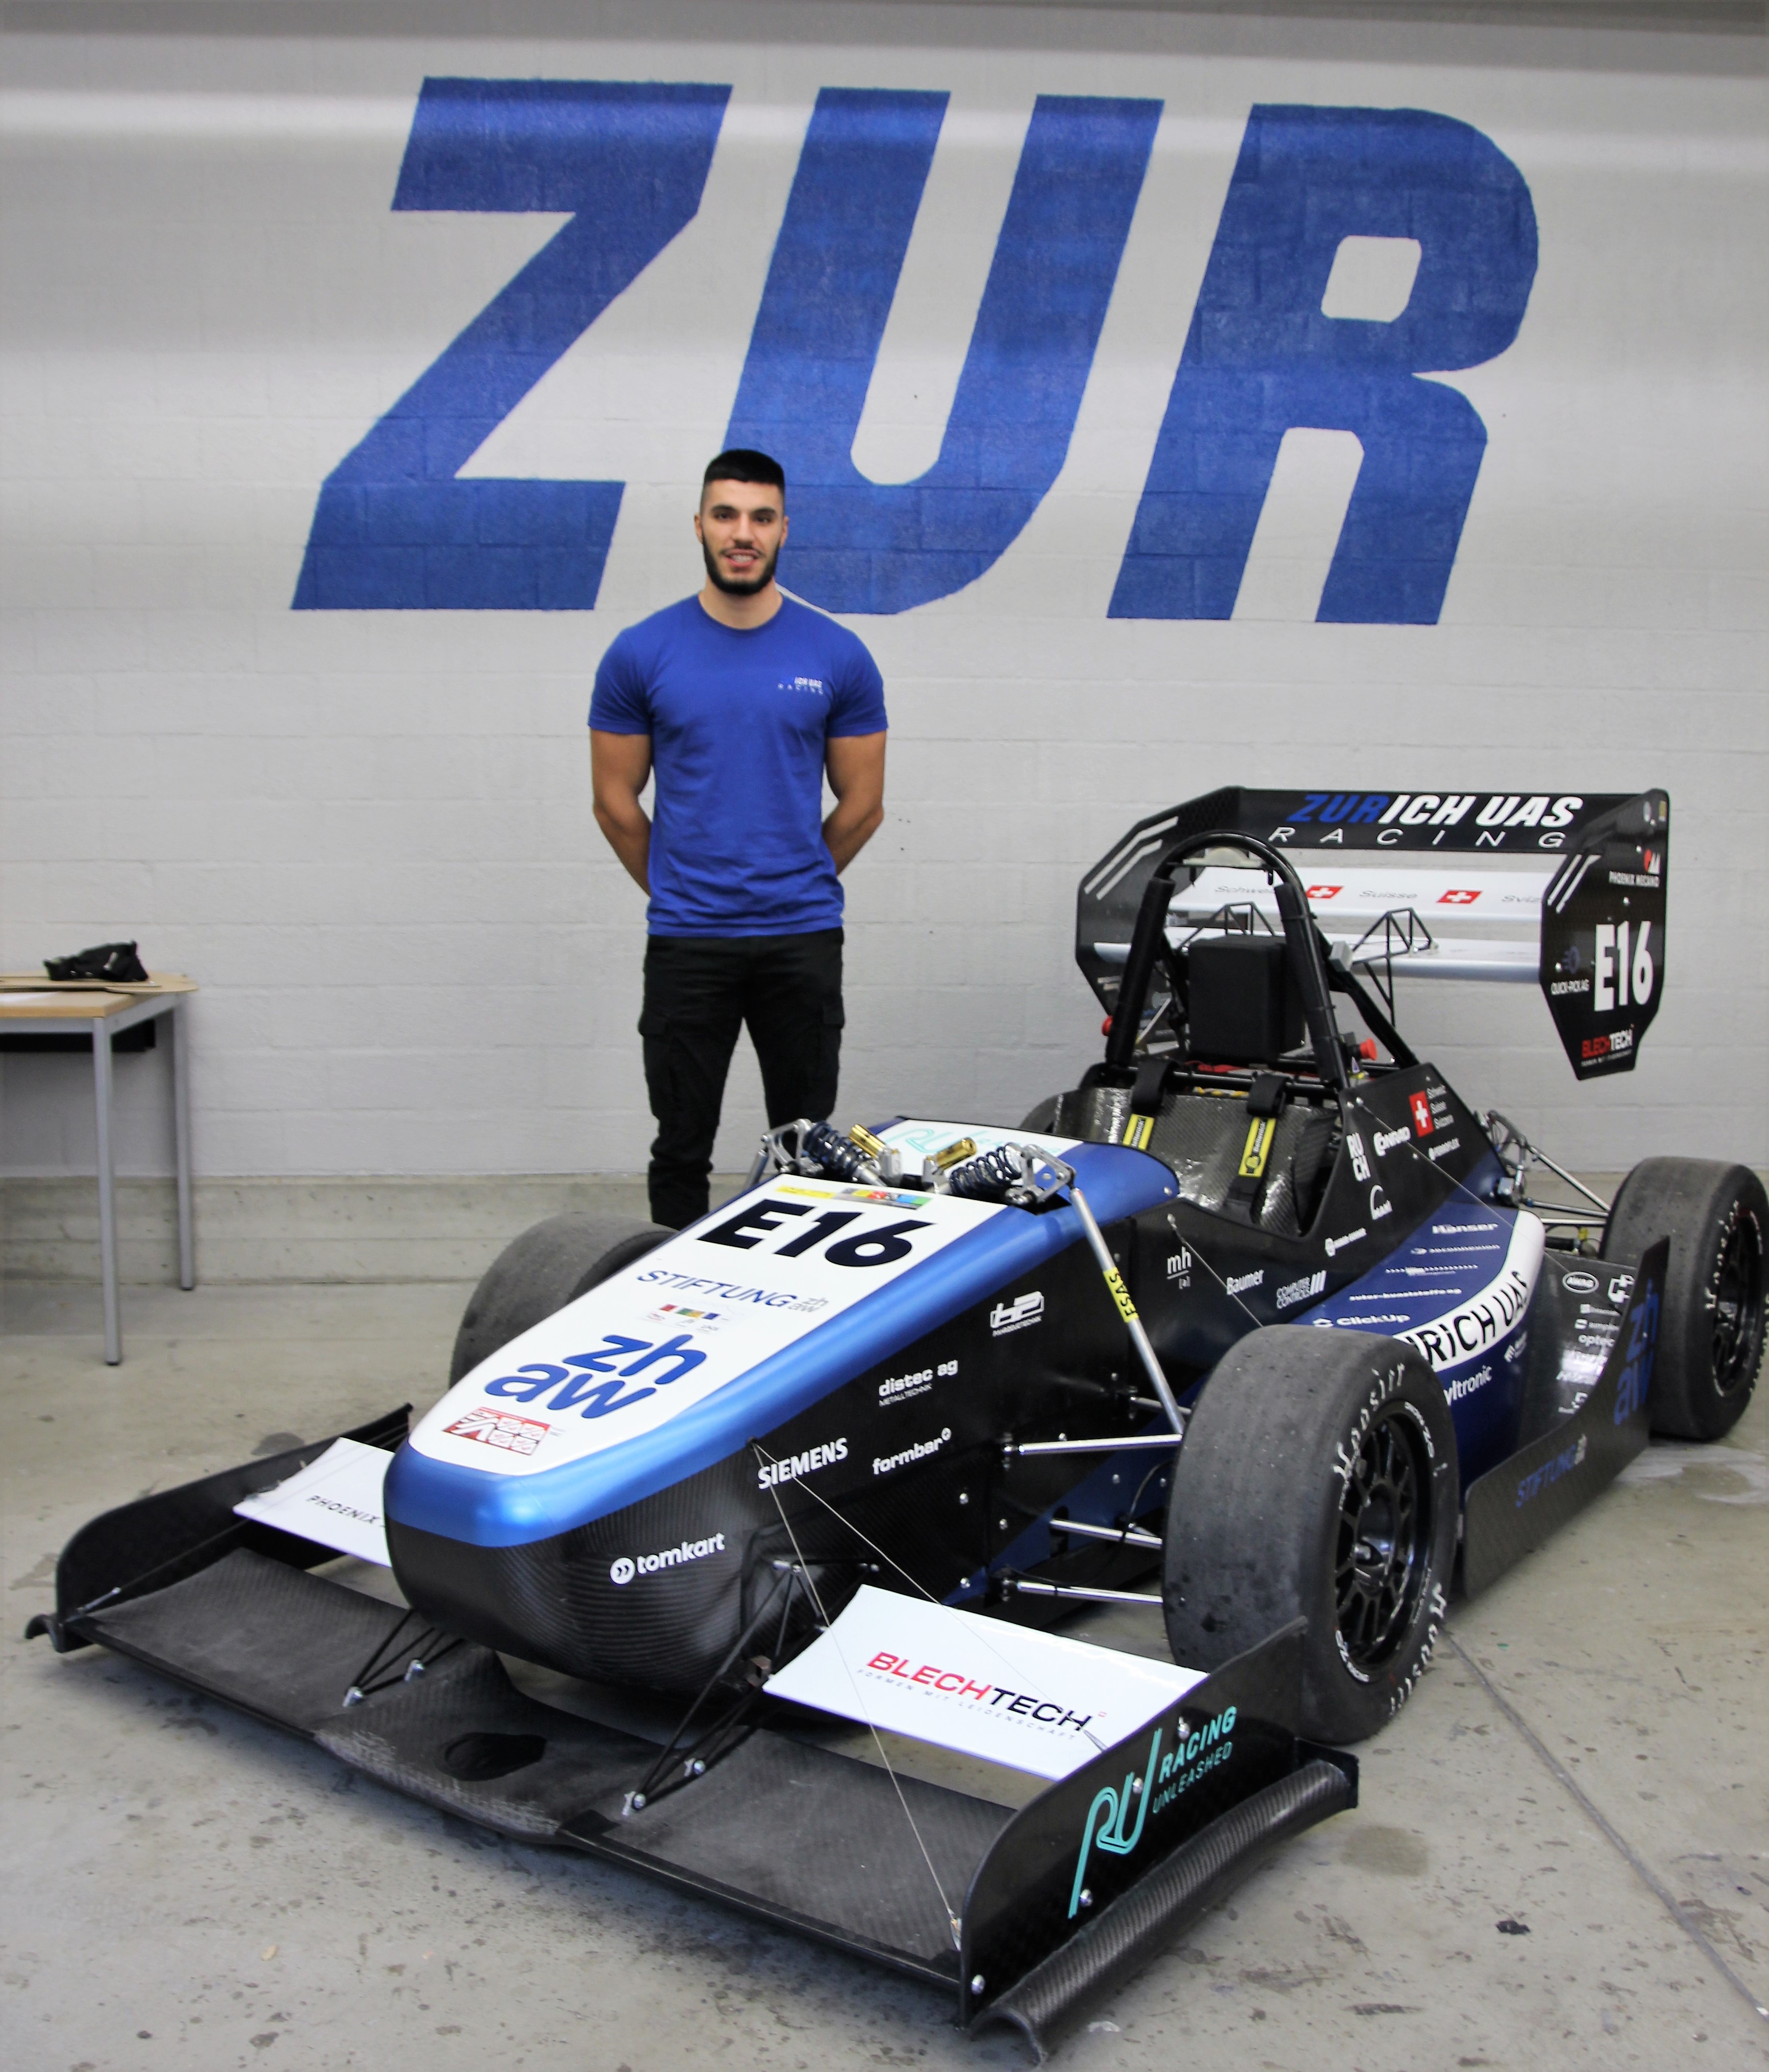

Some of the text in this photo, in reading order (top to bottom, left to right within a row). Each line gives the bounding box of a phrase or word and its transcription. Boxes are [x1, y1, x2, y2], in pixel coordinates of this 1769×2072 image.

[292, 76, 1539, 624] ZUR
[1286, 795, 1585, 829] ZURICH UAS
[1268, 827, 1567, 849] RACING
[1594, 920, 1654, 1012] E16
[696, 1199, 937, 1267] E16
[1167, 1245, 1192, 1274] mh
[1226, 1268, 1265, 1296] Baumer
[637, 1270, 798, 1307] STIFTUNG
[1336, 1313, 1411, 1326] ClickUp
[1405, 1304, 1496, 1365] RICH
[563, 1334, 707, 1385] zh
[879, 1359, 958, 1397] distec ag
[485, 1363, 656, 1419] aw
[757, 1437, 848, 1490] SIEMENS
[872, 1437, 944, 1475] formbar
[306, 1494, 382, 1525] PHOENIX
[636, 1532, 726, 1575] tomkart
[866, 1651, 1094, 1731] BLECHTECH
[1158, 1705, 1238, 1784] RACING
[1152, 1741, 1233, 1814] UNLEASHED
